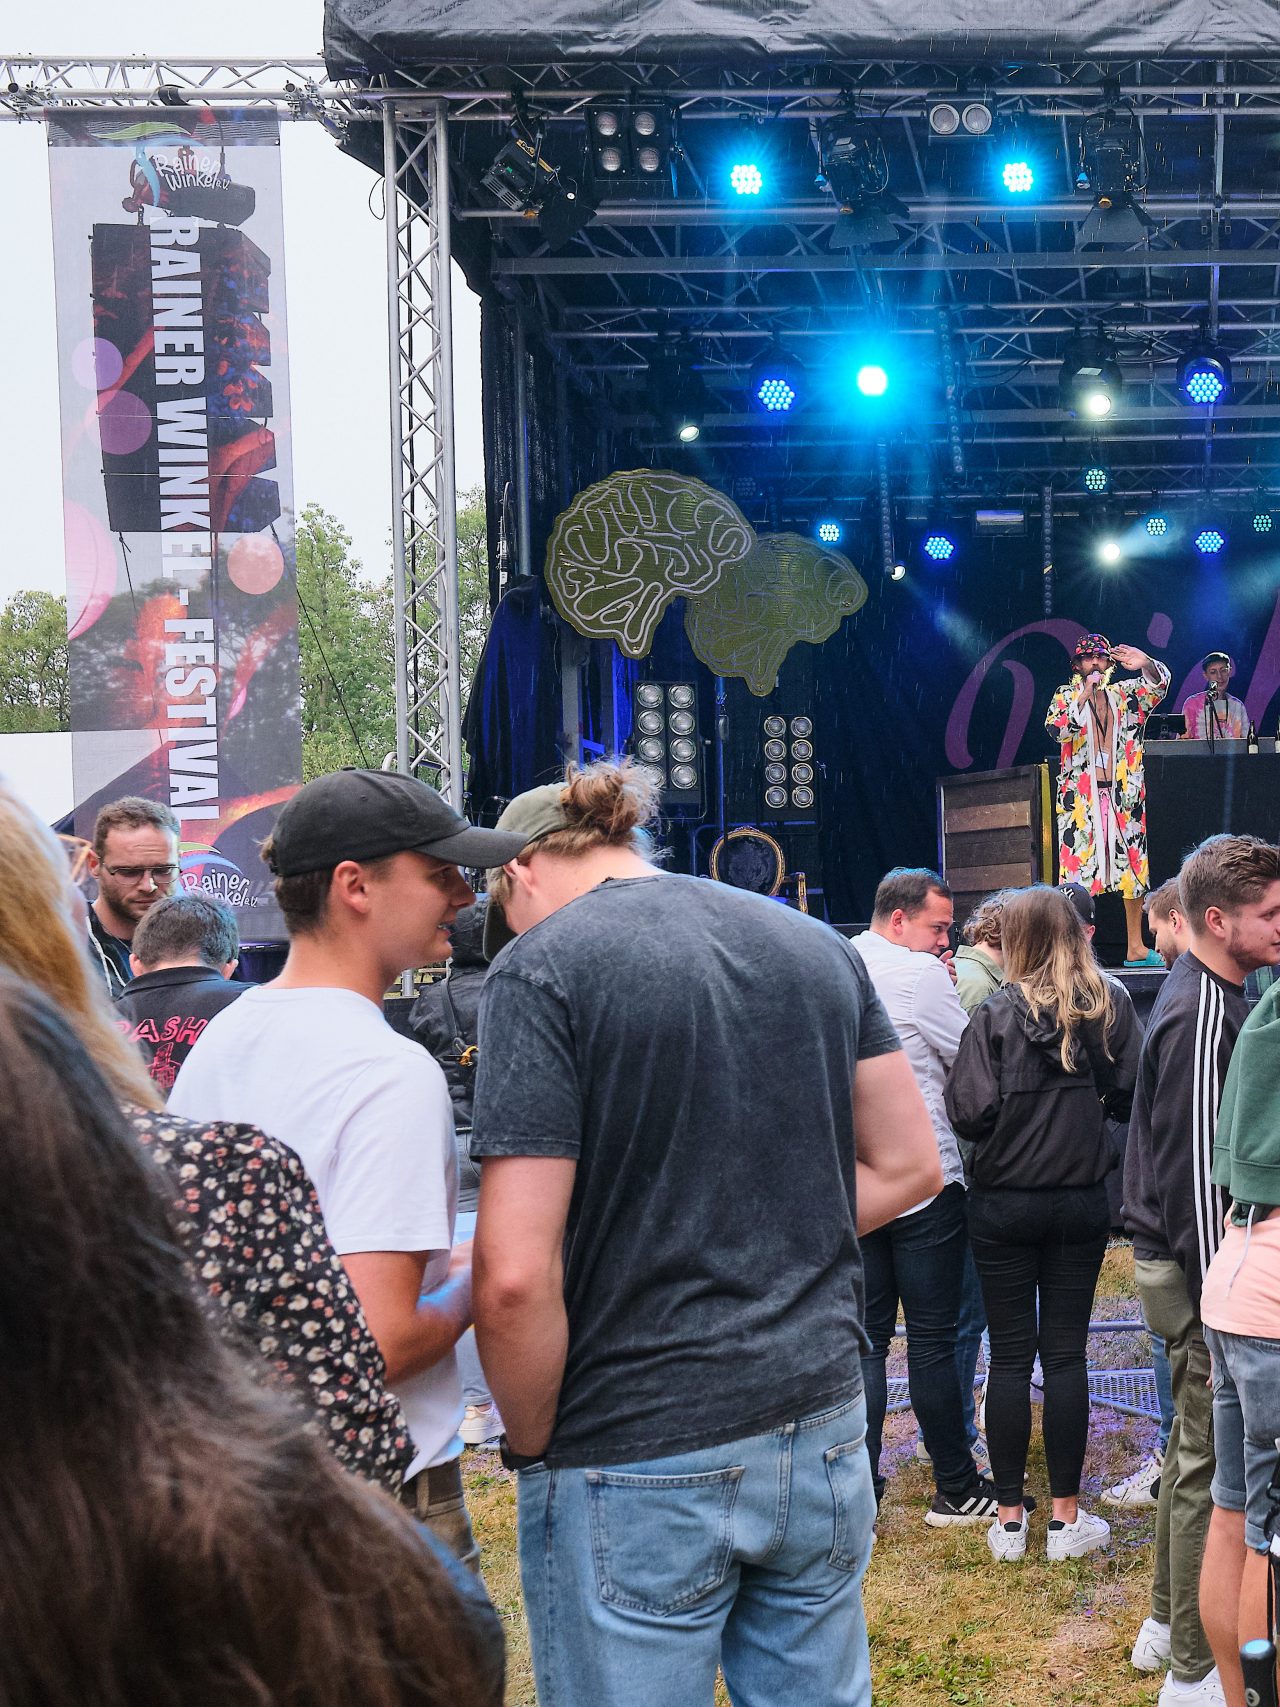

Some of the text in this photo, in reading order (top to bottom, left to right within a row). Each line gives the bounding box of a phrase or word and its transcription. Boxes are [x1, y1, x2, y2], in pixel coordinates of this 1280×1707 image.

[152, 150, 221, 177] Rainer
[165, 168, 218, 192] Winkel
[149, 215, 206, 386] RAINER
[156, 396, 213, 579] WINKEL
[164, 618, 220, 828] FESTIVAL
[181, 868, 250, 894] Rainer
